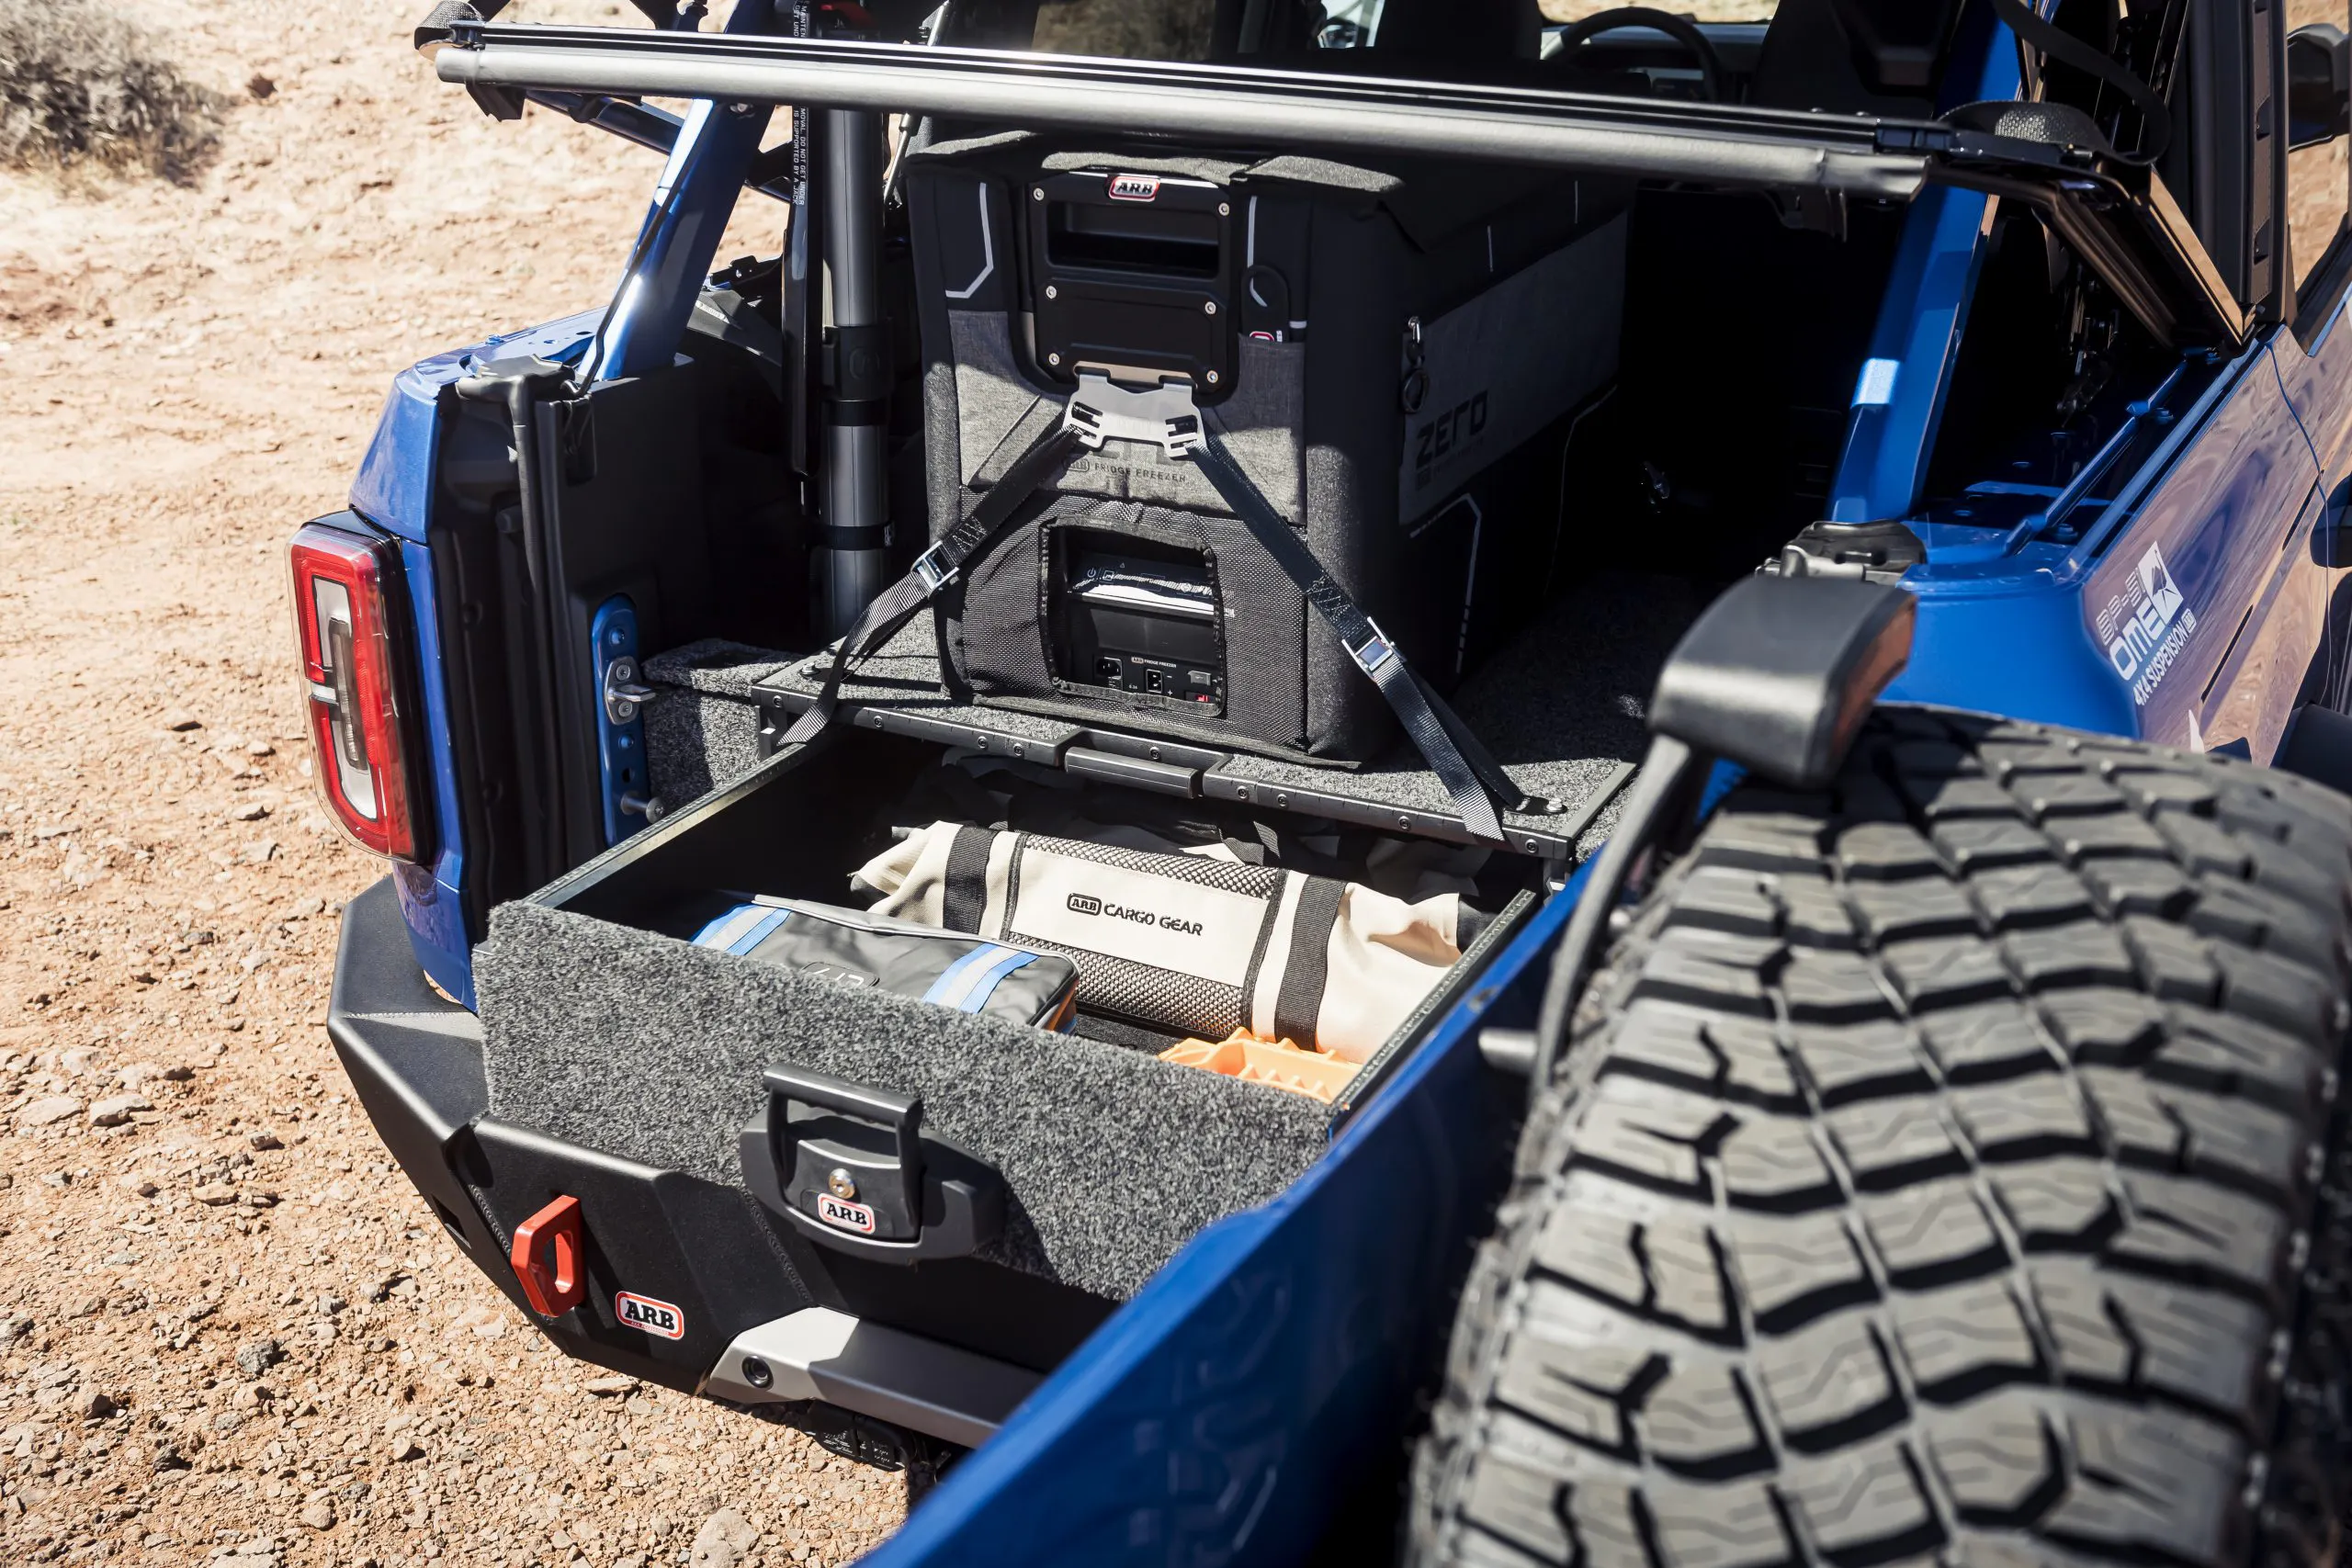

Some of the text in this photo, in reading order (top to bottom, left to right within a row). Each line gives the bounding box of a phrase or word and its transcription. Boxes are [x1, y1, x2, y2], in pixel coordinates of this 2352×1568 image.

[799, 136, 806, 146] DO
[793, 165, 799, 175] BY
[1117, 182, 1153, 193] ARB
[1094, 463, 1131, 476] FRIDGE
[1136, 468, 1187, 482] FREEZER
[2109, 597, 2165, 680] OME
[2132, 675, 2154, 705] 4X4
[2145, 621, 2188, 688] SUSPENSION
[1071, 898, 1204, 936] ARB CARGO GEAR
[827, 1202, 867, 1225] ARB
[625, 1300, 675, 1330] ARB
